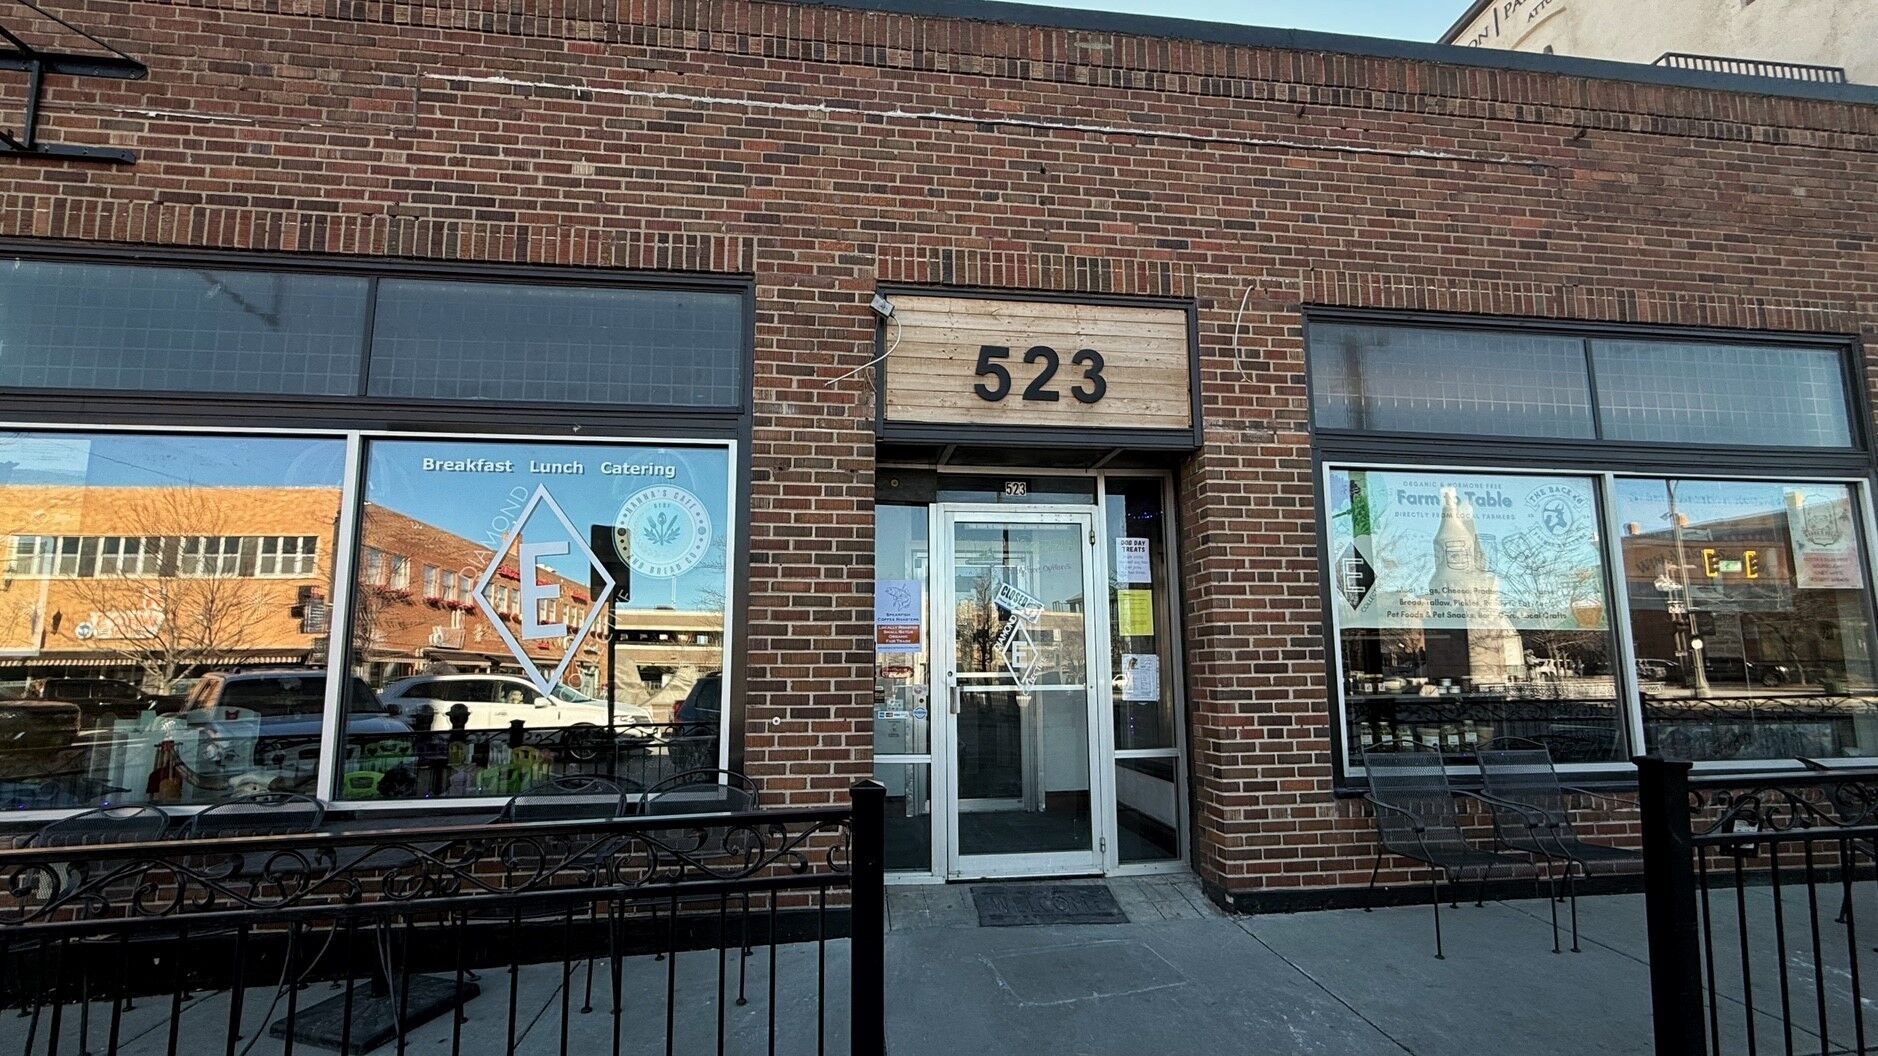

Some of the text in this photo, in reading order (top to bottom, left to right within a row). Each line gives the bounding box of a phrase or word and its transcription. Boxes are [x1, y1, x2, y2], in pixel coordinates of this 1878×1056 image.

[1503, 0, 1527, 20] PA
[974, 345, 1107, 403] 523
[422, 458, 677, 479] Breakfast Lunch Catering
[1006, 482, 1027, 495] 523
[1402, 480, 1437, 488] ORGANIC
[624, 489, 668, 514] HANNA'S
[1396, 488, 1440, 506] Farm
[1464, 490, 1513, 508] Table
[1529, 488, 1547, 503] THE
[1548, 486, 1572, 497] BACK
[1394, 511, 1429, 519] DIRECTLY
[458, 486, 529, 582] DIAMOND
[519, 541, 570, 640] E
[1000, 585, 1029, 608] CLOSED
[1386, 610, 1400, 618] Pet
[1433, 611, 1445, 619] Pet
[994, 614, 1019, 651] DIAMOND
